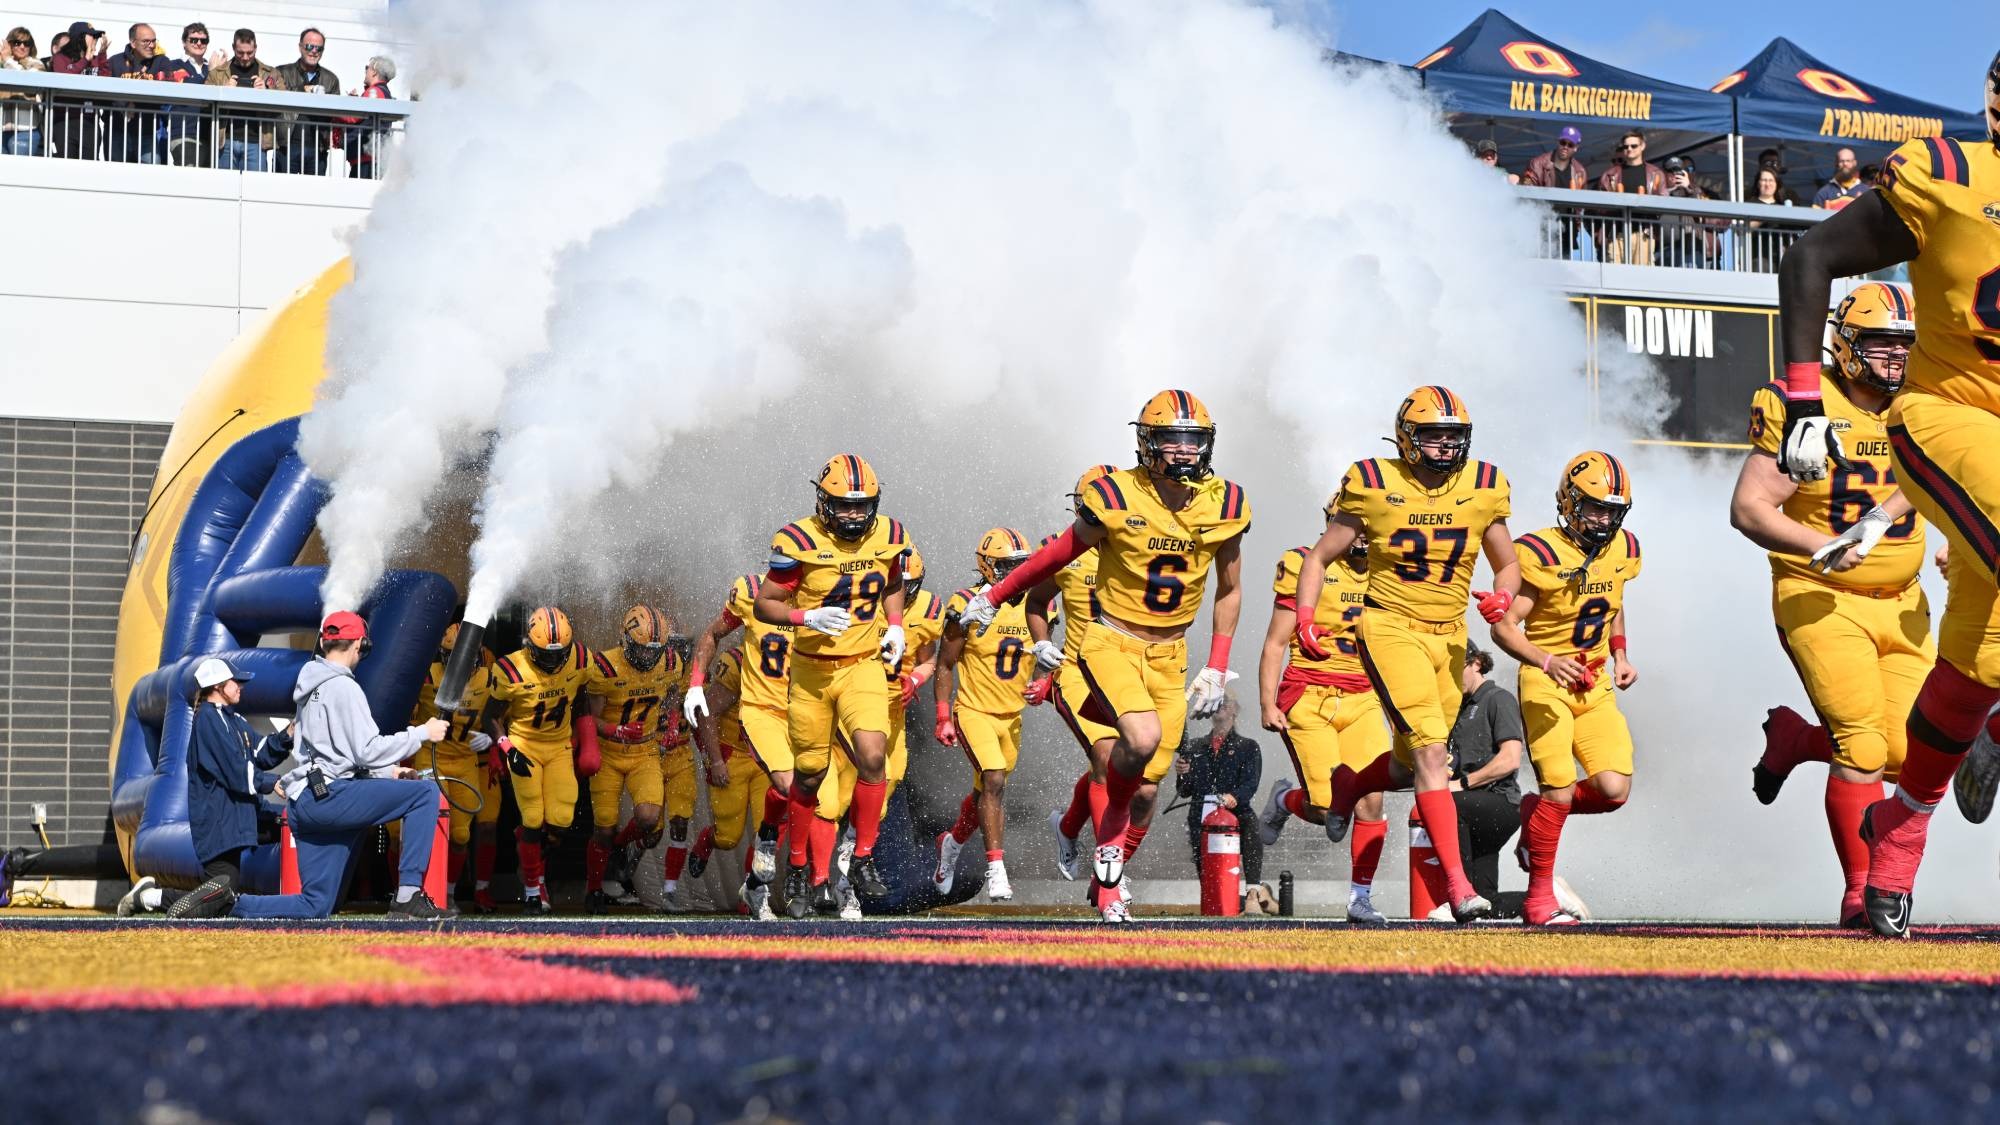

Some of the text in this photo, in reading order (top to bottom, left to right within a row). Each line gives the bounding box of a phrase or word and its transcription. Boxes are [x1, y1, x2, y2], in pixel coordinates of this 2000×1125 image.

[1510, 81, 1652, 120] NA BANRIGHINN
[1625, 305, 1714, 358] DOWN
[1856, 441, 1889, 457] QUEE
[1570, 460, 1590, 477] 8
[1408, 513, 1453, 526] QUEEN'S
[983, 536, 992, 550] 0
[1147, 537, 1197, 552] QUEEN'S
[839, 559, 874, 575] QUEEN'S
[1388, 527, 1469, 585] 37
[1143, 554, 1189, 615] 6
[1577, 580, 1613, 596] QUEEN'S
[820, 571, 886, 622] 49
[1340, 591, 1366, 604] QUEE
[997, 625, 1028, 636] QUEEN'S
[1570, 596, 1611, 650] 8
[760, 632, 792, 679] 8
[995, 637, 1024, 681] 0
[538, 687, 566, 700] QUEEN'S
[531, 696, 569, 729] 14
[619, 696, 660, 726] 17
